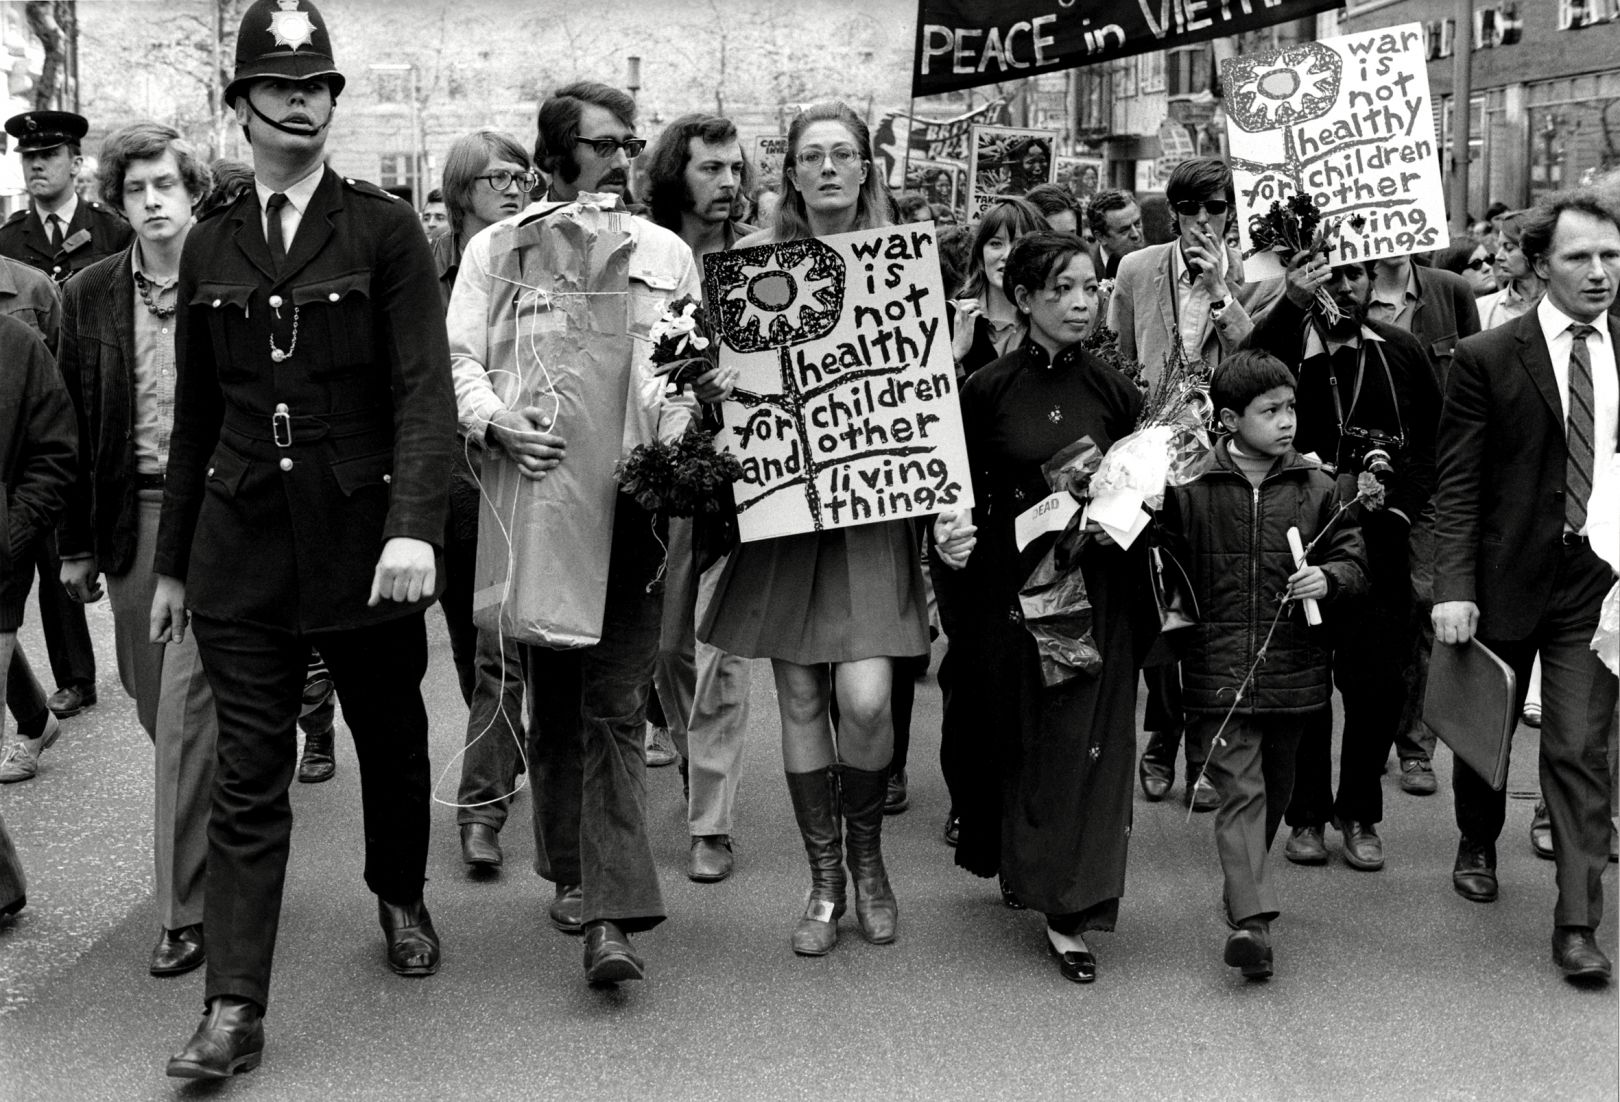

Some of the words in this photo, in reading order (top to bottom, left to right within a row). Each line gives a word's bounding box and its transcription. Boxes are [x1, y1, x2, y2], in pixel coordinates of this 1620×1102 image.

[921, 14, 1060, 75] PEACE
[1083, 18, 1126, 56] in
[1349, 32, 1417, 55] war
[1360, 57, 1393, 82] is
[1349, 72, 1415, 109] not
[1298, 97, 1422, 157] healthy
[1242, 174, 1293, 208] for
[1309, 139, 1431, 188] children
[1313, 171, 1421, 207] other
[975, 195, 996, 203] TAK
[851, 231, 933, 261] war
[865, 263, 904, 294] is
[854, 284, 929, 329] not
[797, 317, 939, 387] healthy
[733, 409, 793, 449] for
[812, 373, 950, 429] children
[742, 439, 801, 487] and
[818, 412, 940, 453] other
[831, 459, 949, 493] living
[824, 482, 962, 524] things
